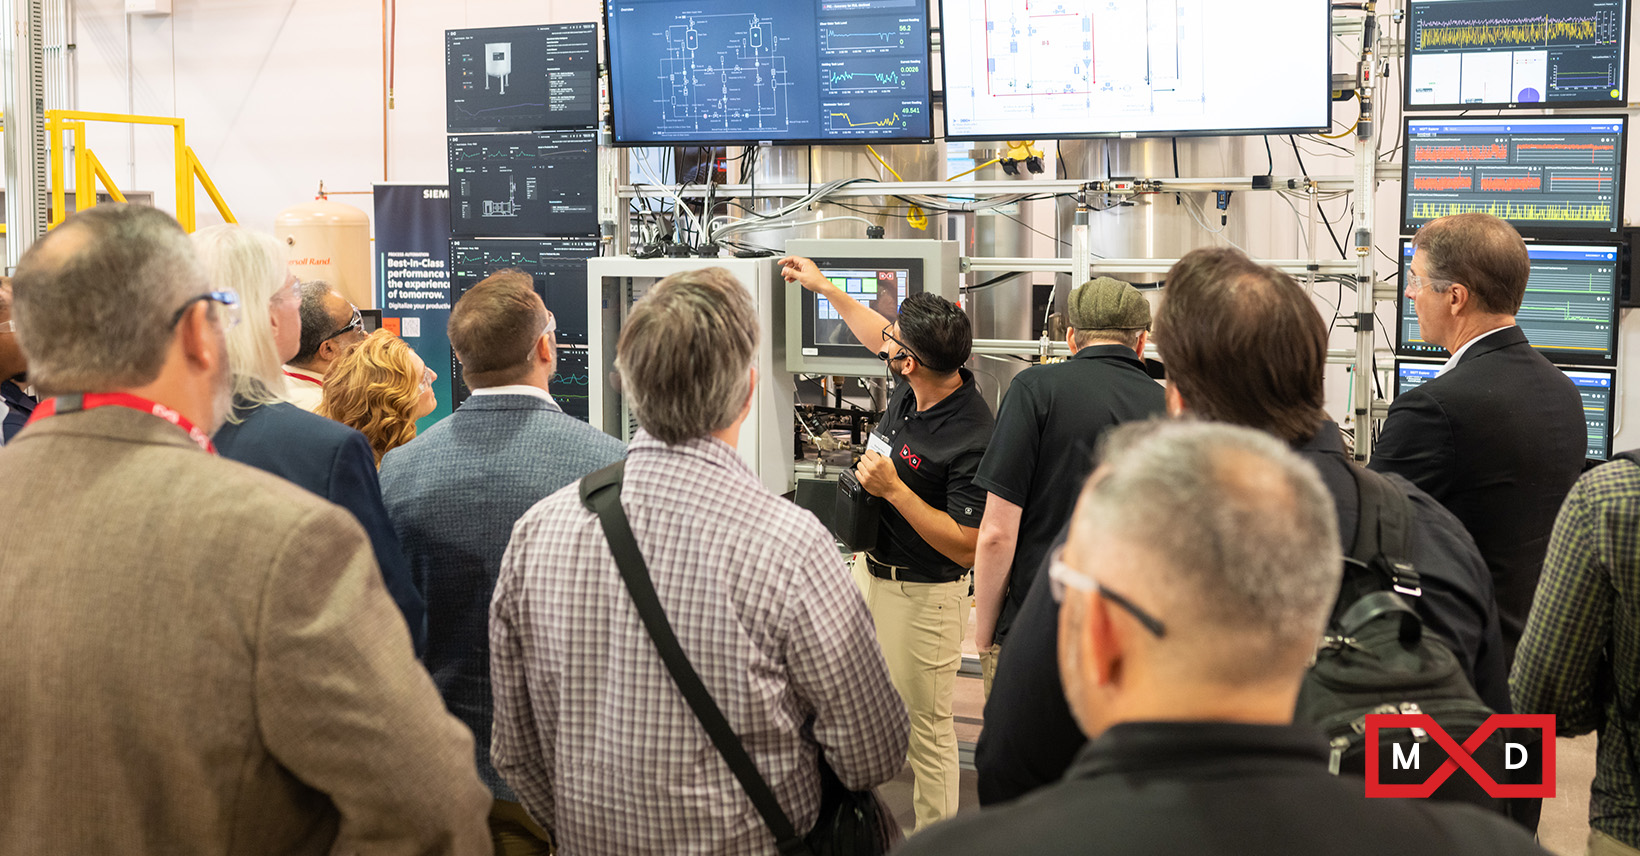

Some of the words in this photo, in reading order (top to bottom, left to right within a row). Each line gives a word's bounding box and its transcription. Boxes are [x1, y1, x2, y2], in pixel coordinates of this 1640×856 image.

[423, 189, 449, 199] SIEM
[309, 257, 330, 265] Rand
[388, 269, 444, 280] performance
[387, 279, 403, 288] the
[388, 289, 398, 299] of
[399, 290, 444, 299] tomorrow.
